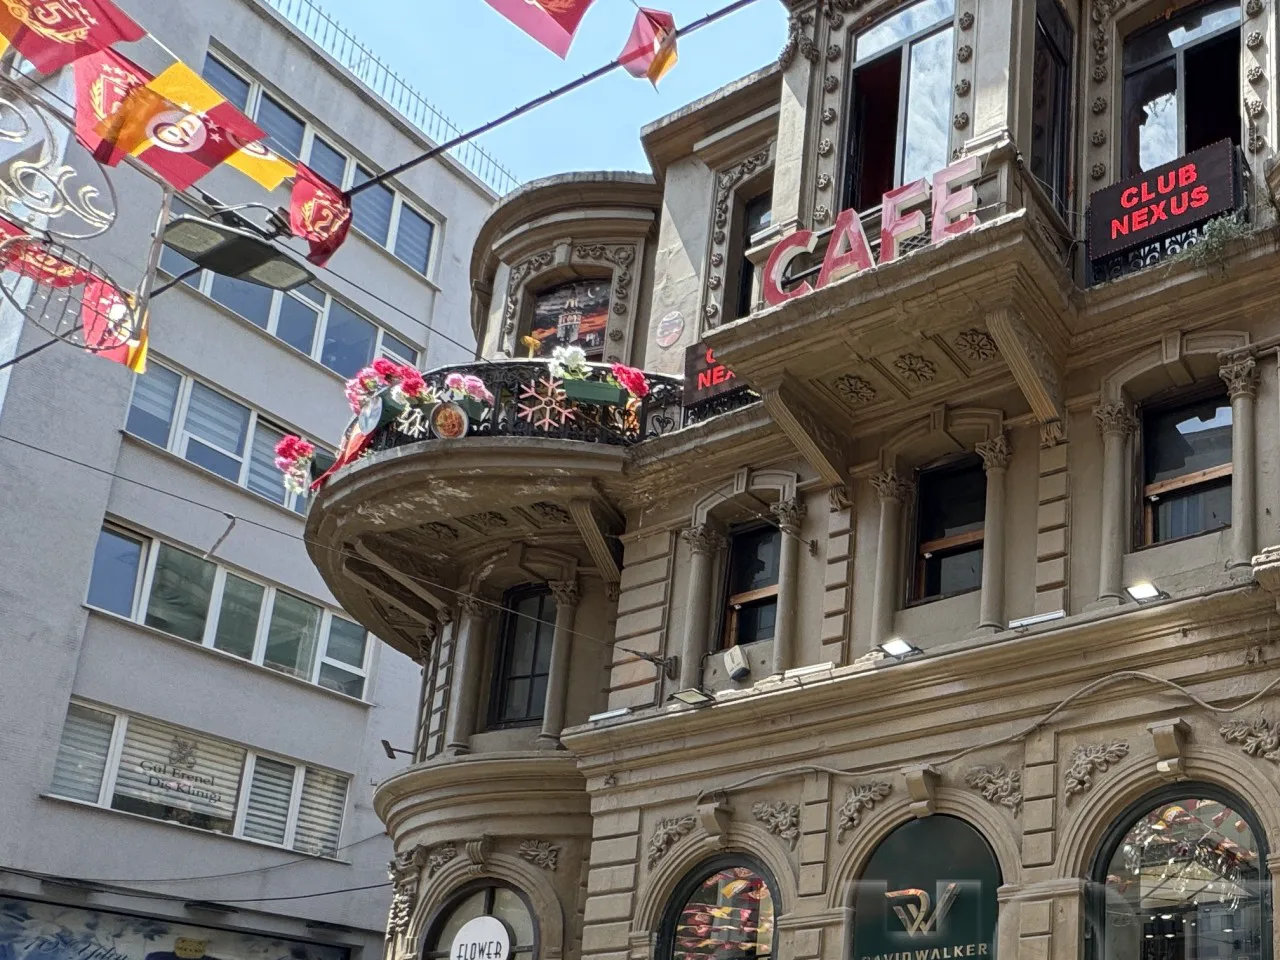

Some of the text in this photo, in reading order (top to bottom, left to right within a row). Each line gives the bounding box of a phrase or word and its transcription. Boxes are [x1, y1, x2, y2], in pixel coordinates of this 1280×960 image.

[1110, 183, 1211, 240] NEXUS
[1120, 162, 1199, 210] CLUB
[762, 157, 984, 308] CAFE
